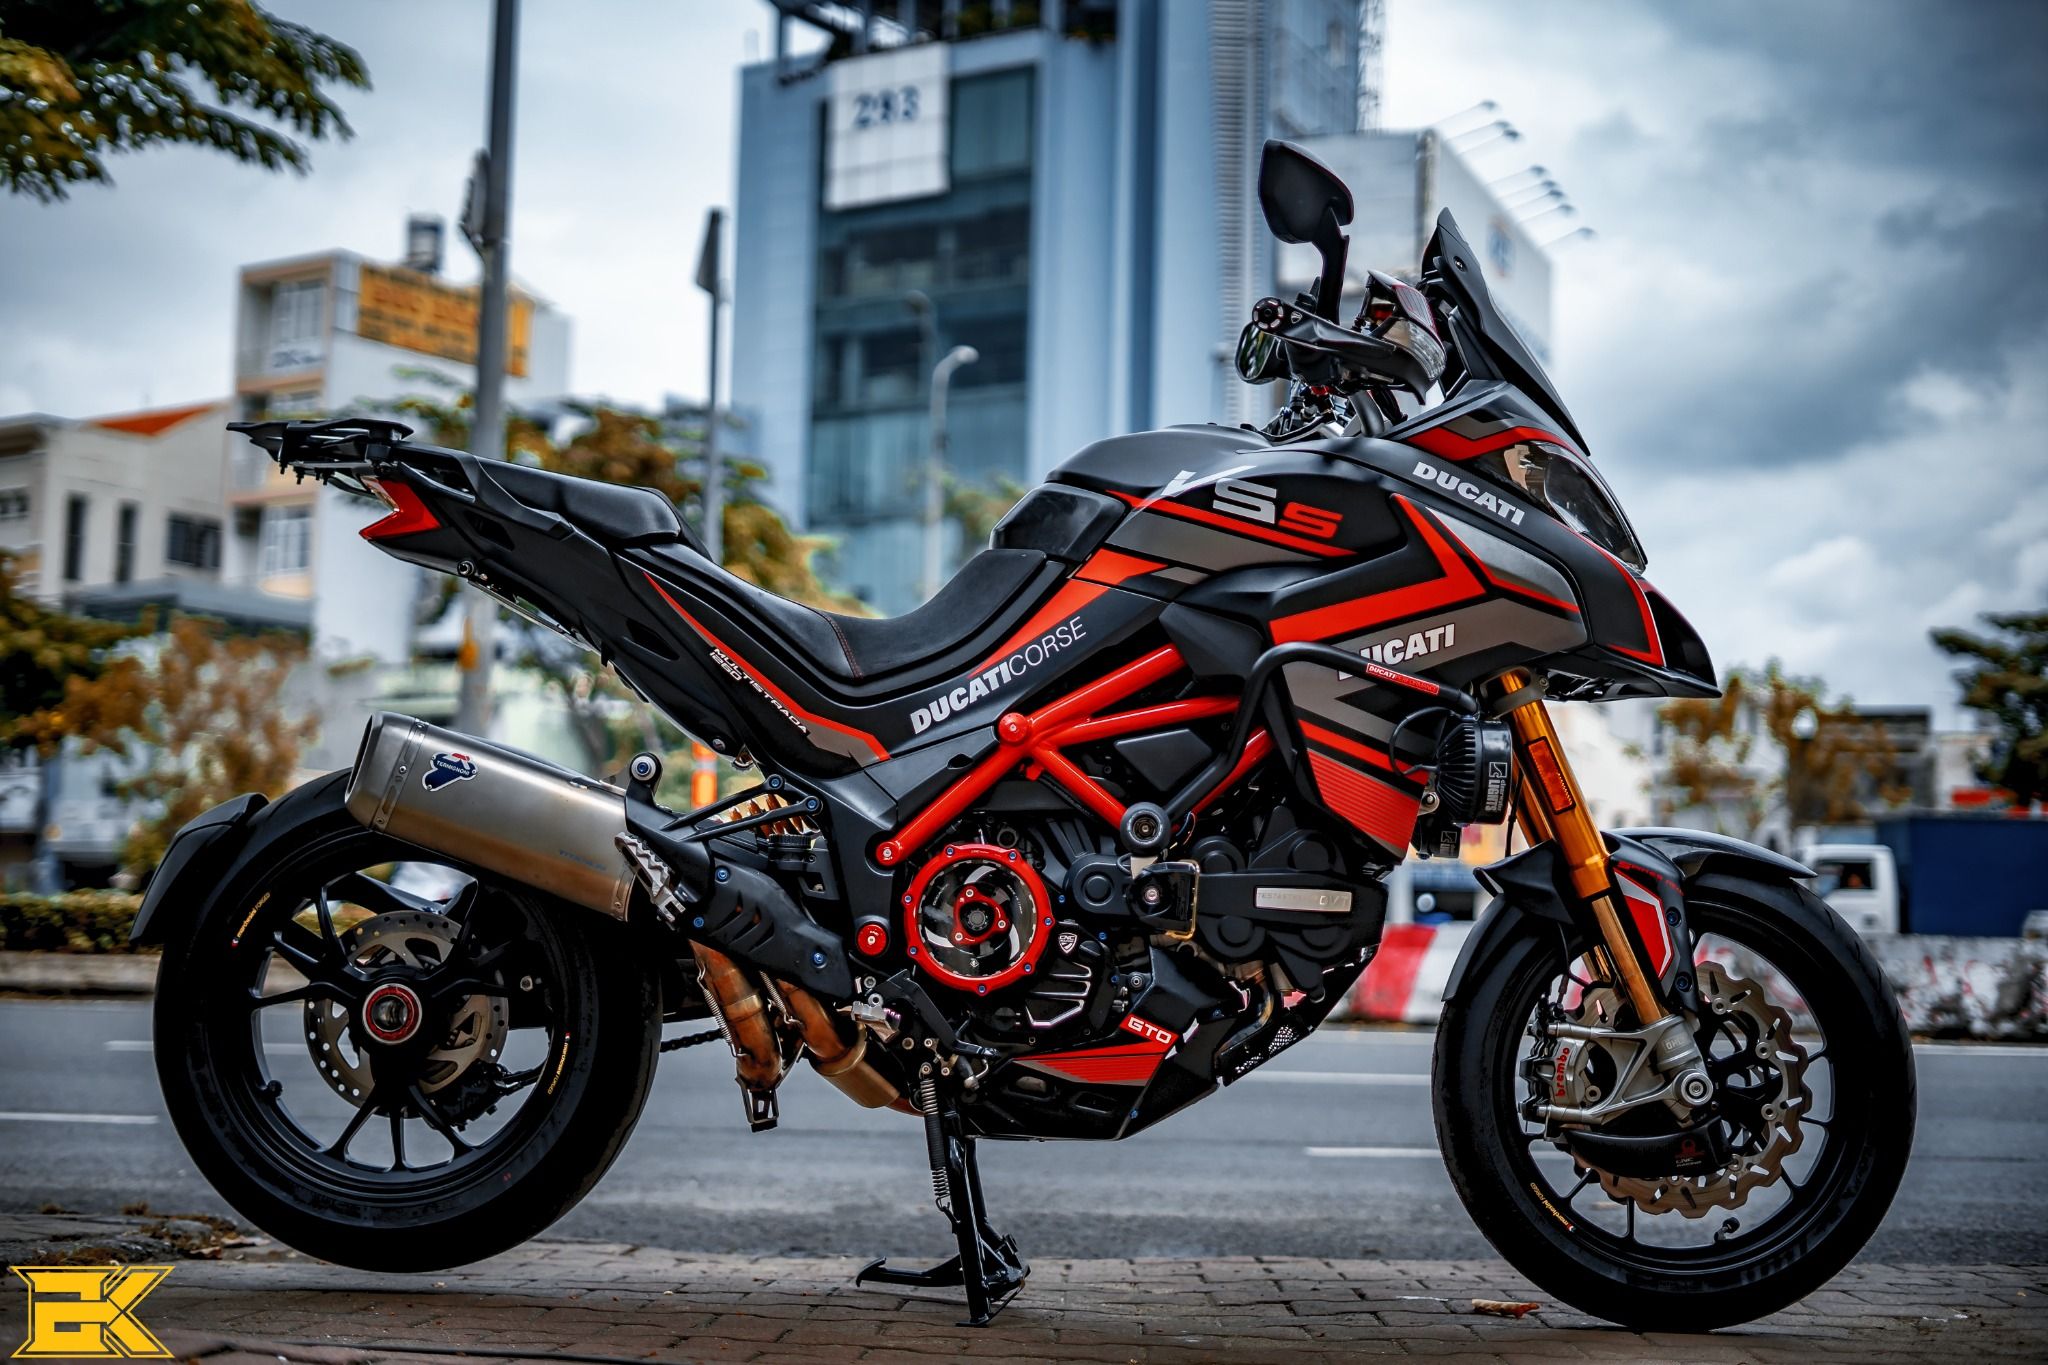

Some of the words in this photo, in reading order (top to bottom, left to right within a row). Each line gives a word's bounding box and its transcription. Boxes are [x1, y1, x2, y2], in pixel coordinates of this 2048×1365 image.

[1412, 461, 1525, 526] DUCATI
[713, 648, 807, 733] MULTISTRADA
[1484, 779, 1500, 812] LIGHTS
[1127, 1016, 1172, 1044] GTO
[1555, 1047, 1570, 1097] brembo
